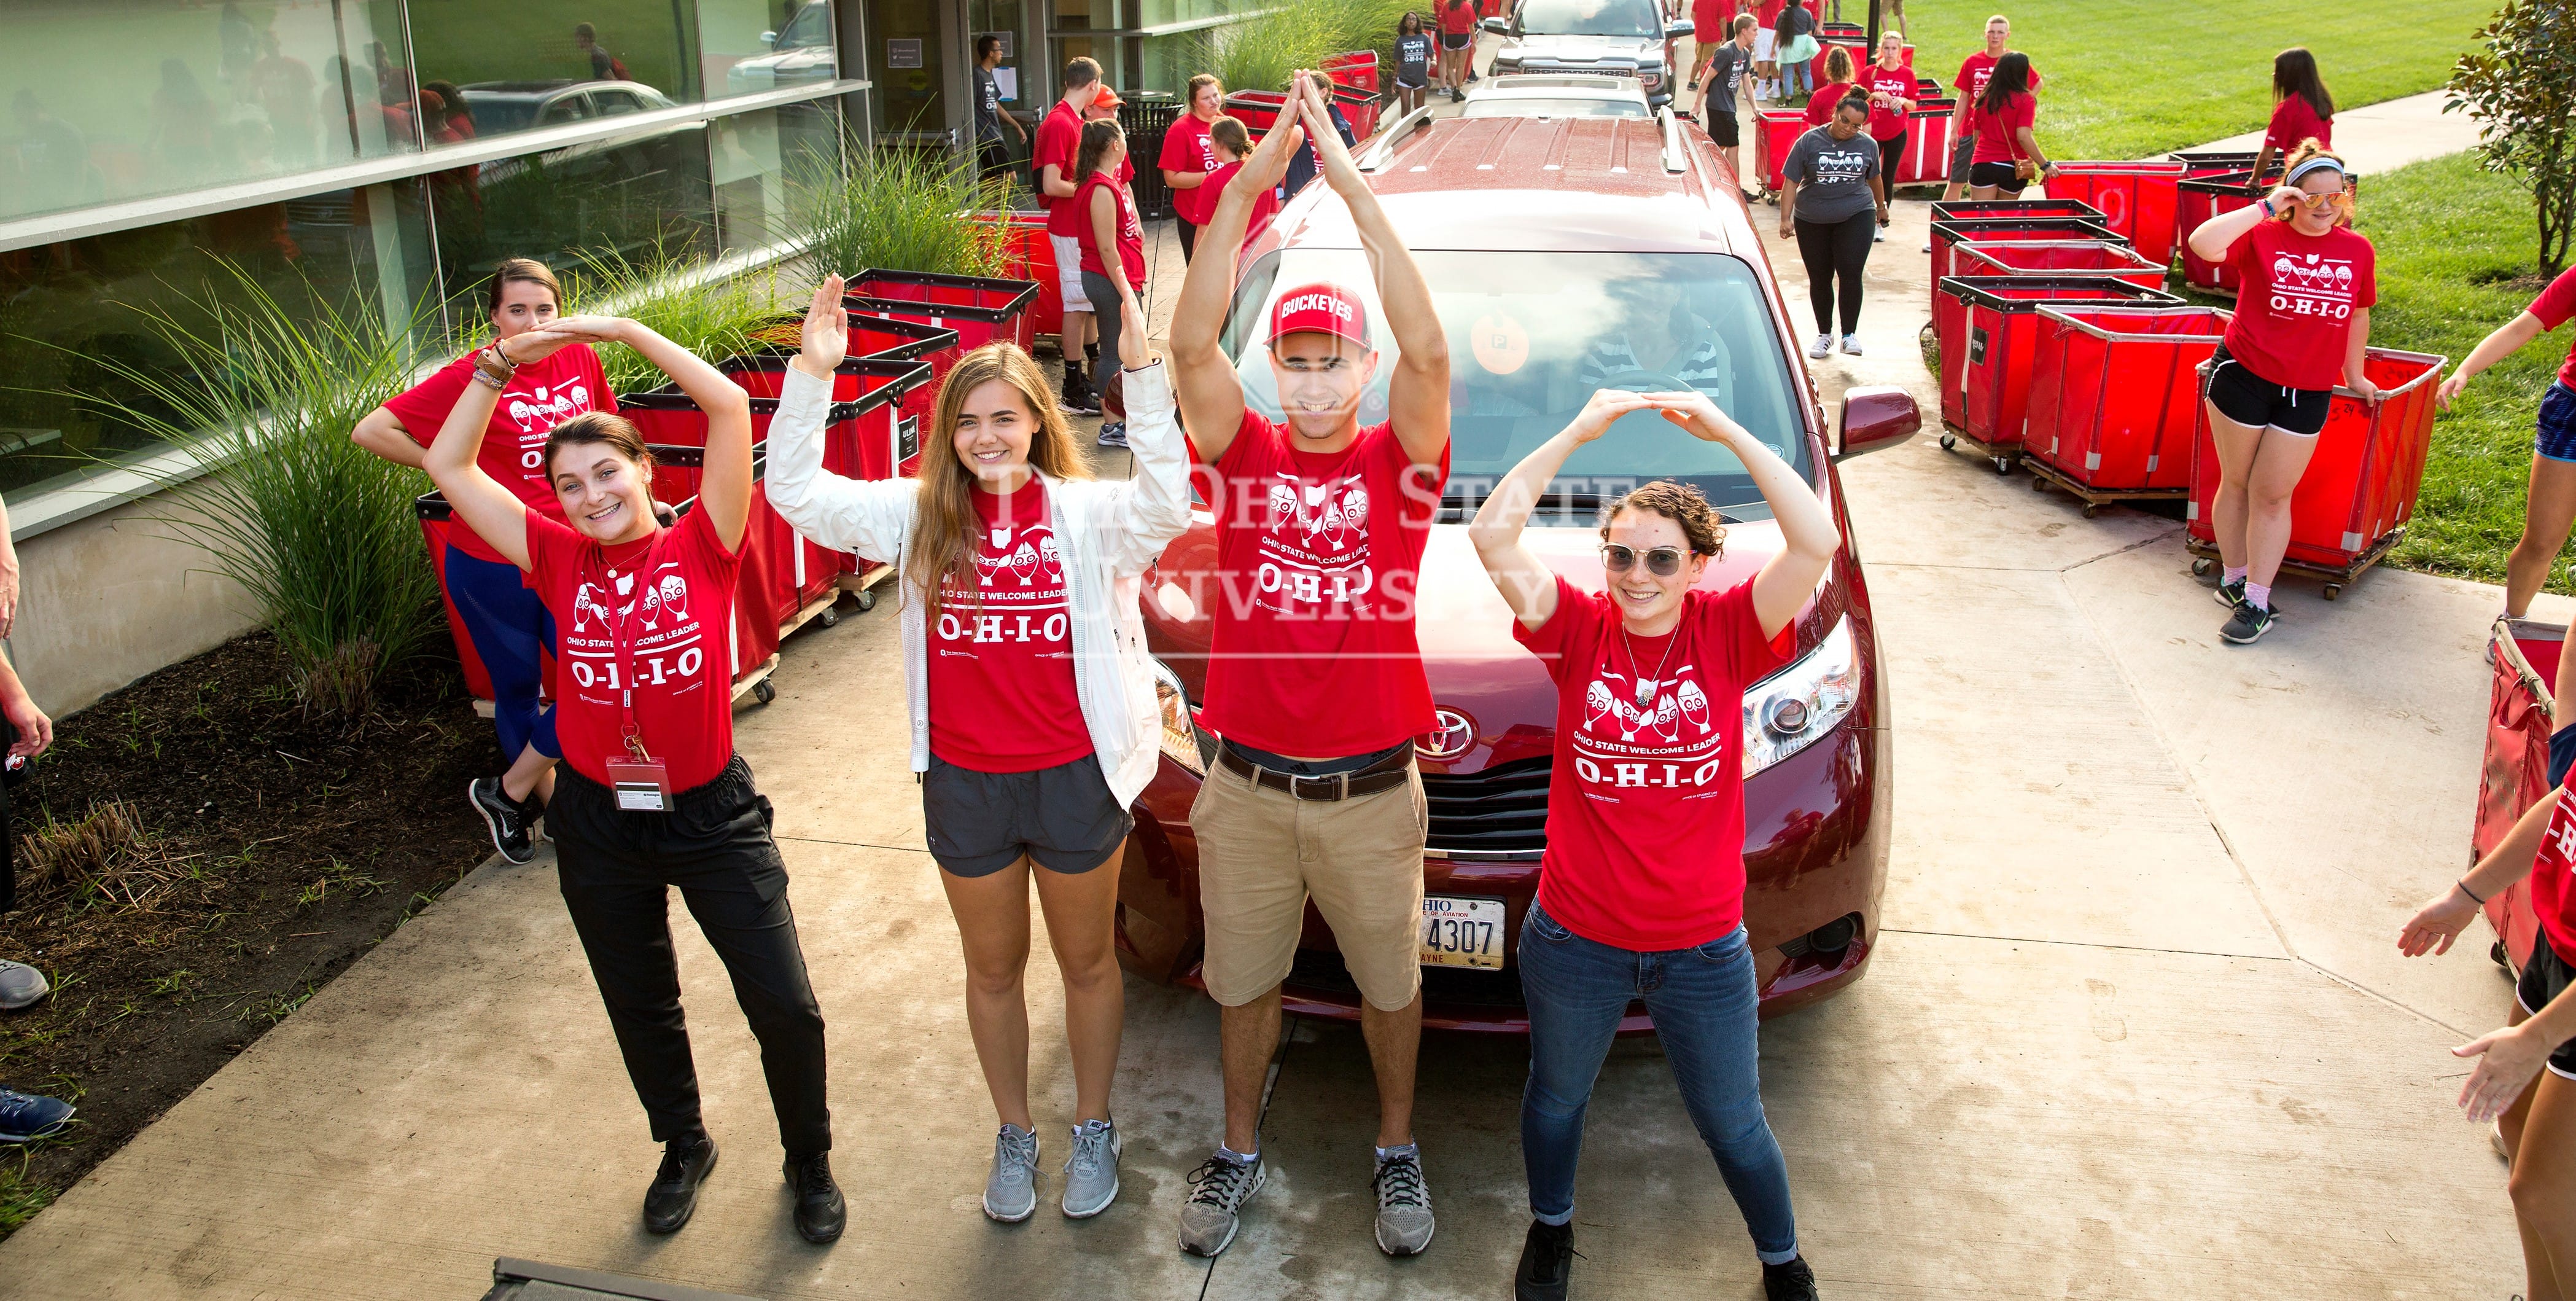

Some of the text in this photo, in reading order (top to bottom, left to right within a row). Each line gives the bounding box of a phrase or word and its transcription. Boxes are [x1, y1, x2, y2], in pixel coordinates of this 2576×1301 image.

[1281, 293, 1353, 322] BUCKEYES
[2270, 295, 2350, 319] O-H-I-O
[518, 433, 538, 442] OHIO
[1262, 536, 1281, 550] OHIO
[1280, 544, 1305, 559] STATE
[1306, 553, 1350, 565] WELCOME
[987, 591, 1037, 600] WELCOME
[567, 636, 586, 646] OHIO
[588, 639, 614, 648] STATE
[666, 621, 700, 639] LEADER
[936, 612, 1068, 644] O-H-I-O
[1573, 730, 1721, 755] OHIO STATE WELCOME LEADER
[1575, 757, 1720, 788] O-H-I-O
[2561, 787, 2576, 807] STA
[1422, 899, 1452, 912] HIO
[1426, 917, 1493, 955] 4307
[1420, 953, 1444, 963] AYNE
